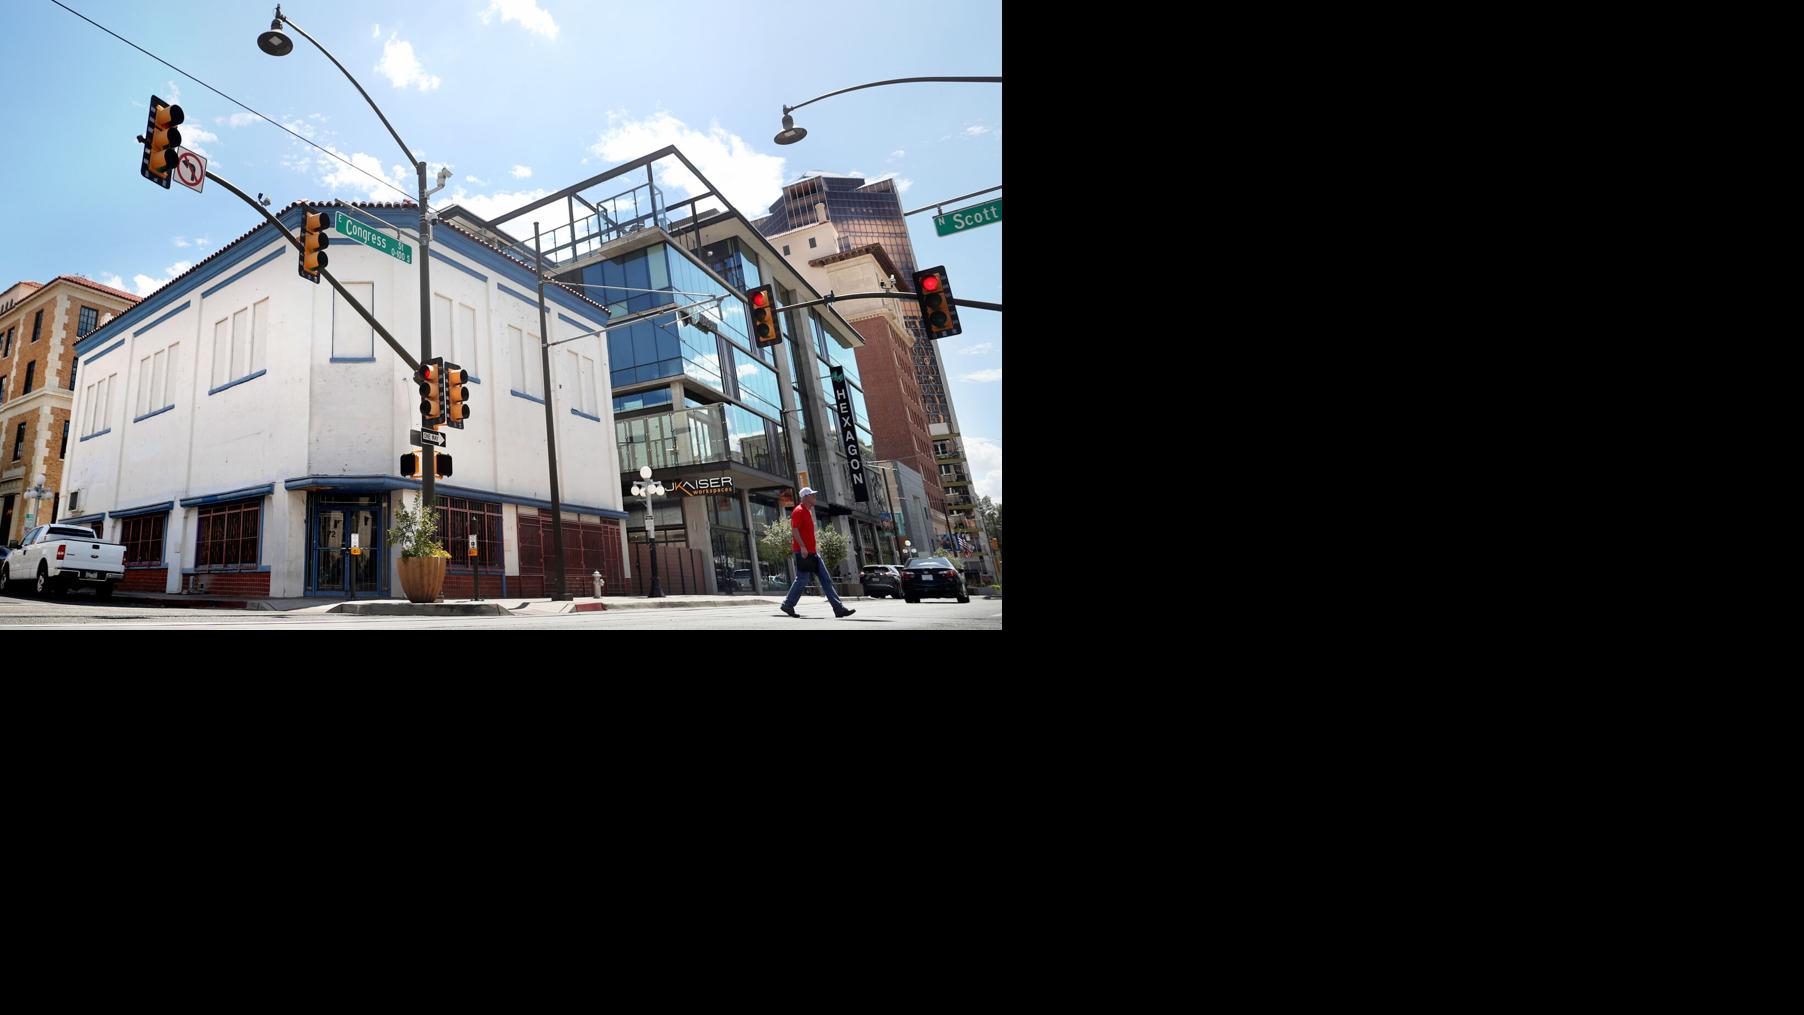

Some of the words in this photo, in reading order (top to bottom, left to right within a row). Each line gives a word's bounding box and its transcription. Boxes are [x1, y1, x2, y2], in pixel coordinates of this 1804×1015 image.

[938, 217, 945, 226] N
[952, 205, 999, 229] Scott
[338, 213, 342, 223] E
[345, 219, 387, 249] Congress
[836, 389, 864, 485] HEXAGON
[664, 476, 733, 497] JKAISER
[692, 486, 733, 495] workspaces
